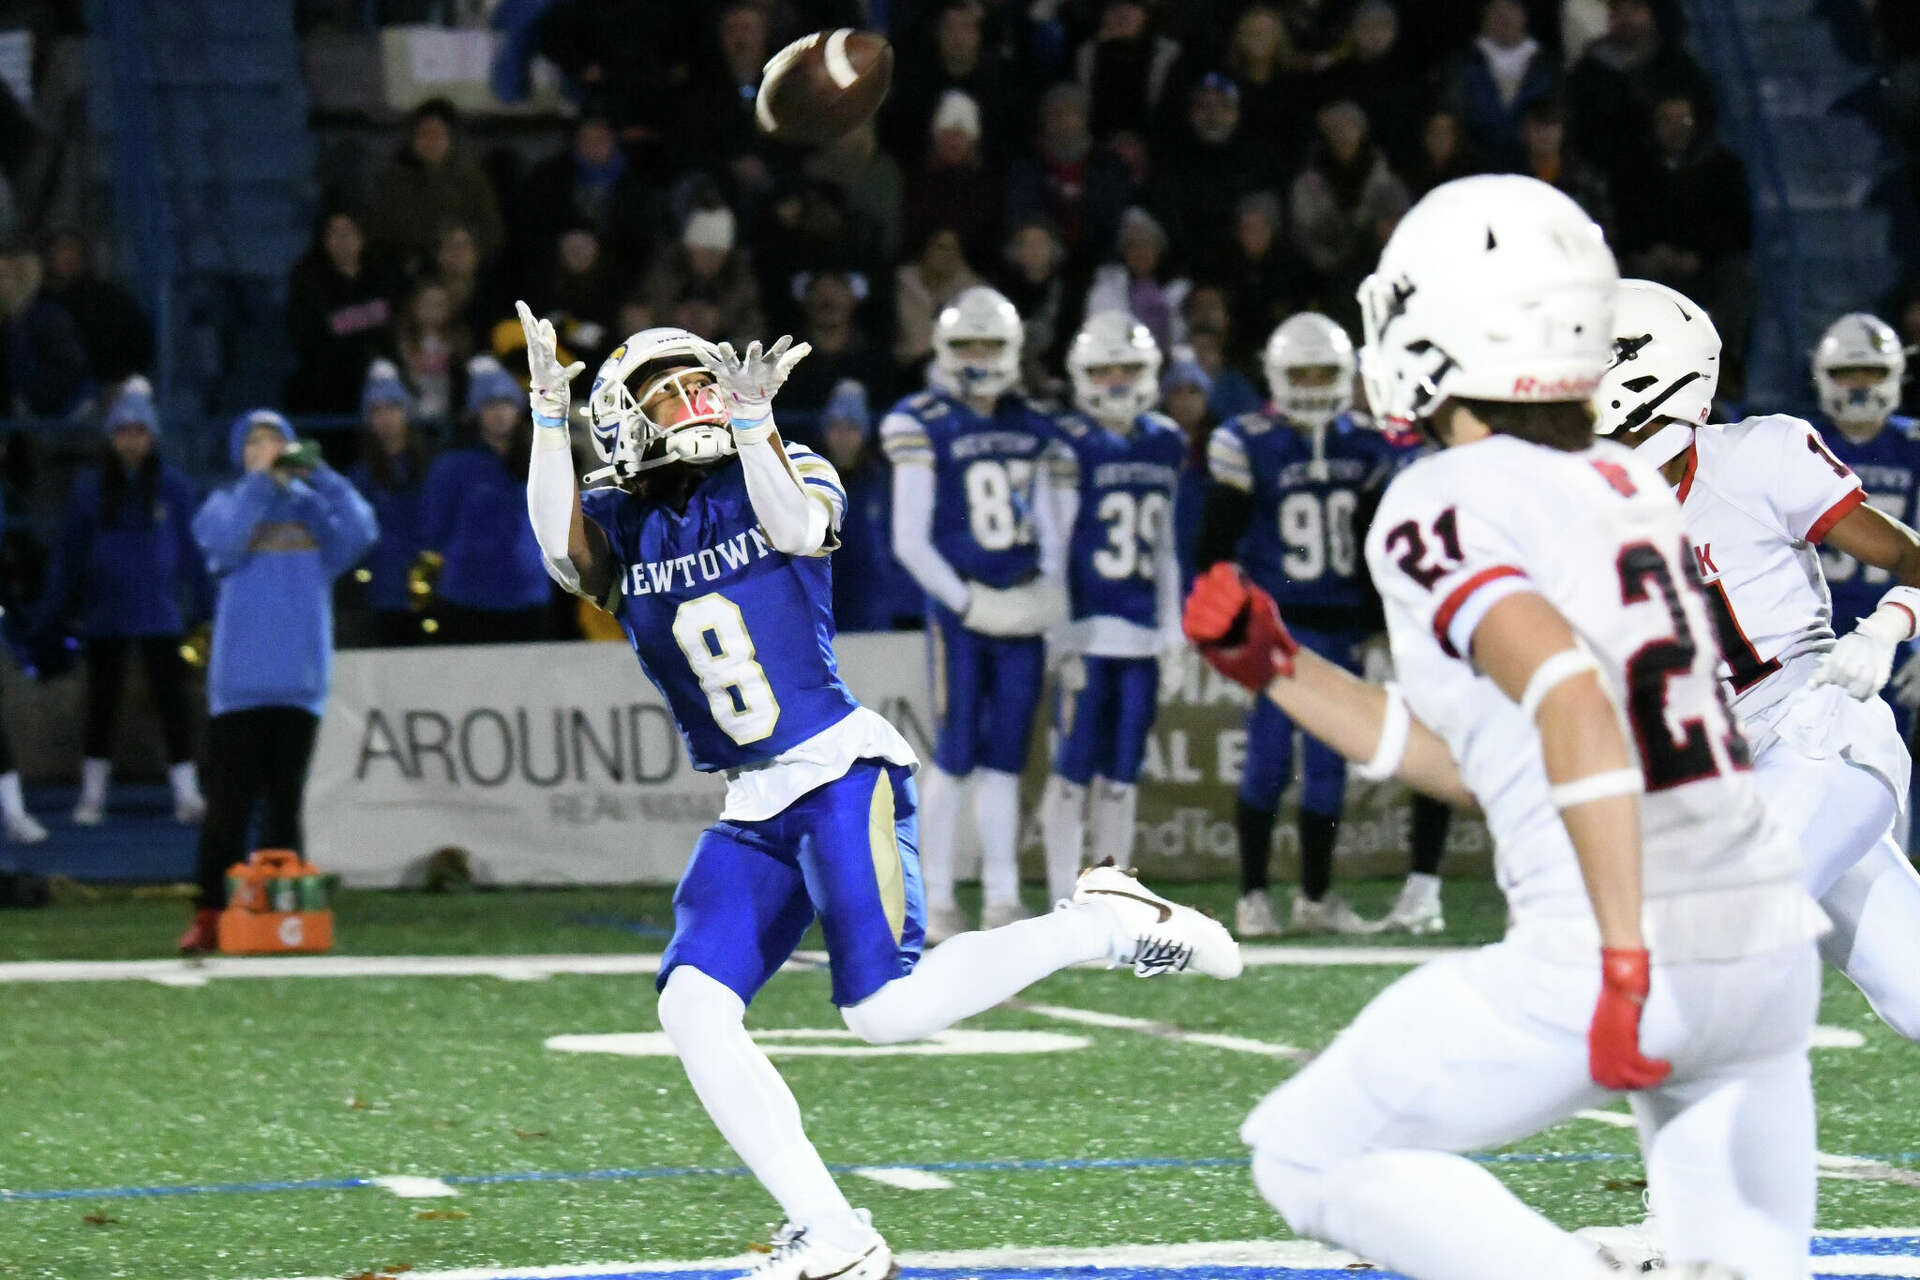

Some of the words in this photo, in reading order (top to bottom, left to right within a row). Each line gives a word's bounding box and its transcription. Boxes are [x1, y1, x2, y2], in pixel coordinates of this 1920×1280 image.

[1385, 505, 1465, 593] 21
[672, 592, 780, 746] 8
[355, 702, 680, 788] AROUND
